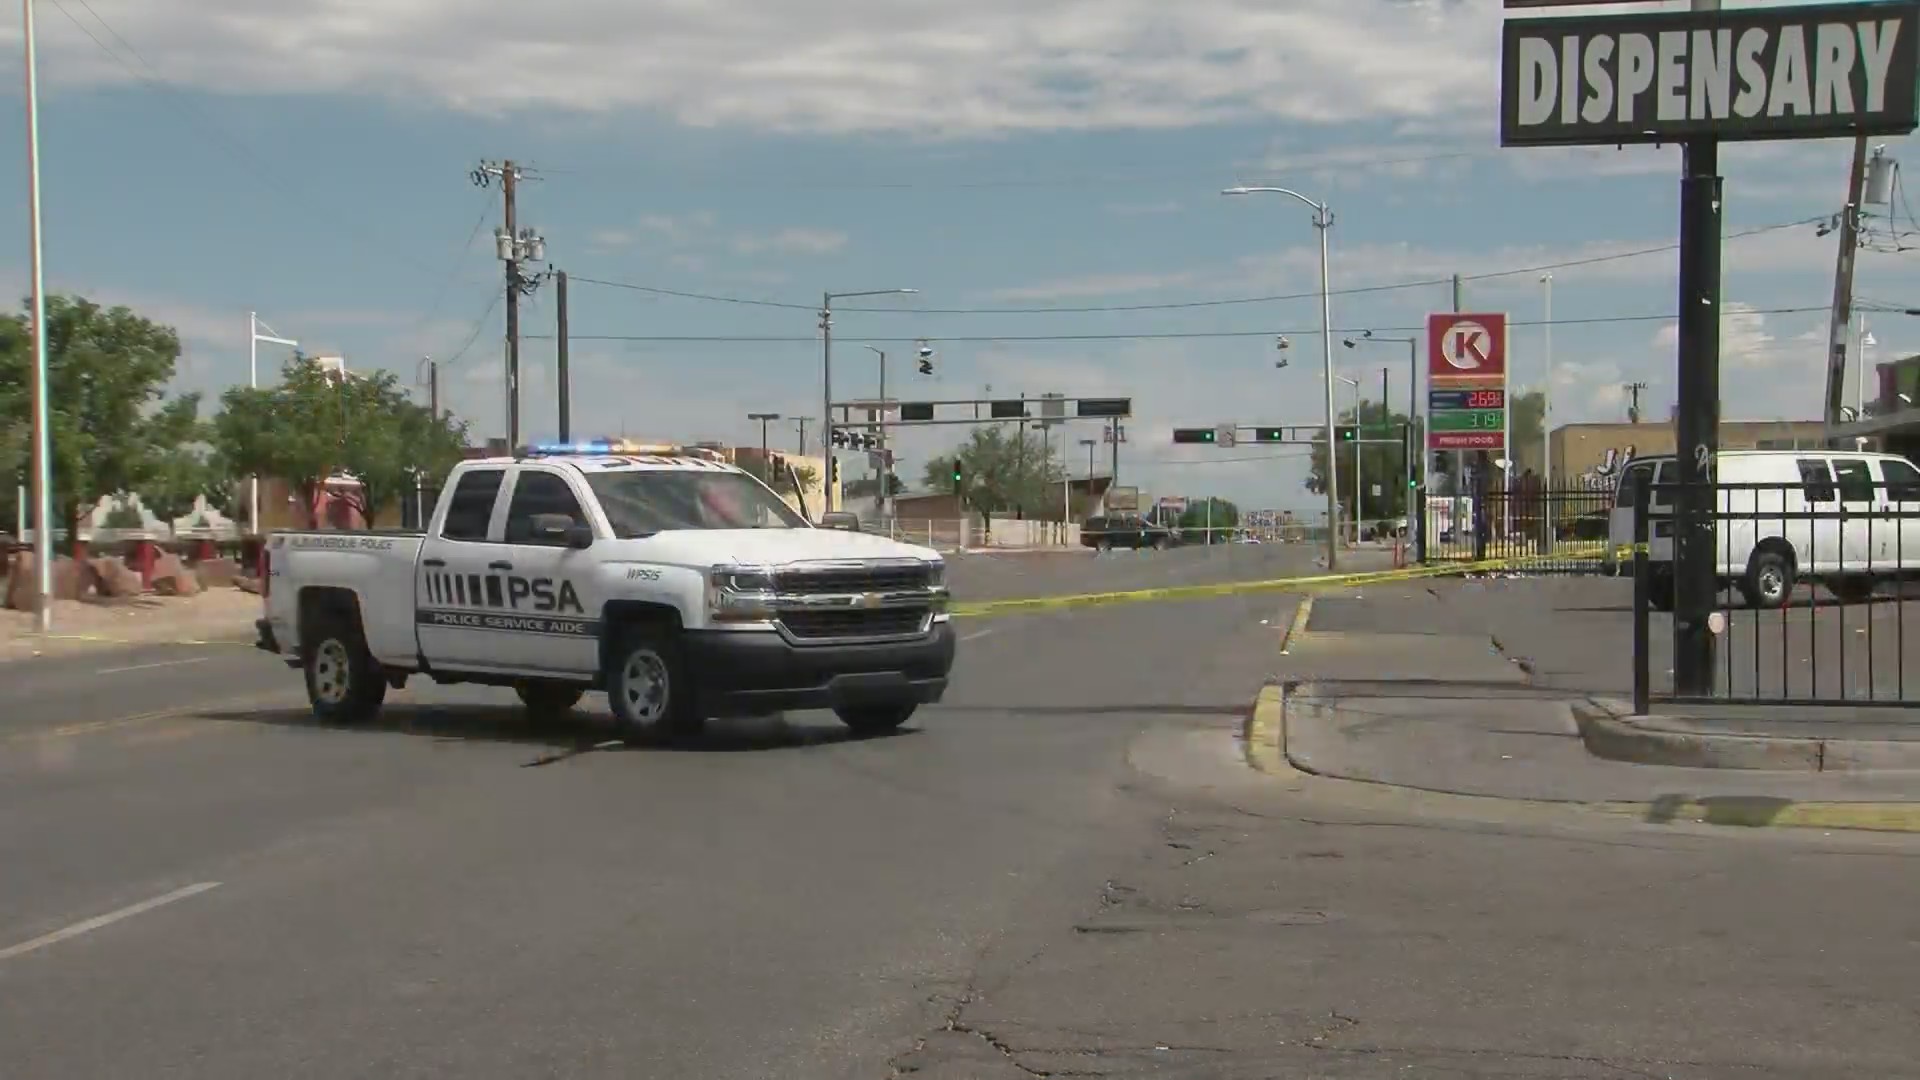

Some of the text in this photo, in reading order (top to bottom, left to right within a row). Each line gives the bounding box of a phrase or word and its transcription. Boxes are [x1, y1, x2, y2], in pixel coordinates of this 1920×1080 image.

[1518, 18, 1902, 126] DISPENSARY
[1455, 331, 1485, 363] K
[1468, 436, 1494, 444] FOOD
[508, 576, 584, 613] PSA
[434, 613, 585, 633] POLICE SERVICE AIDE
